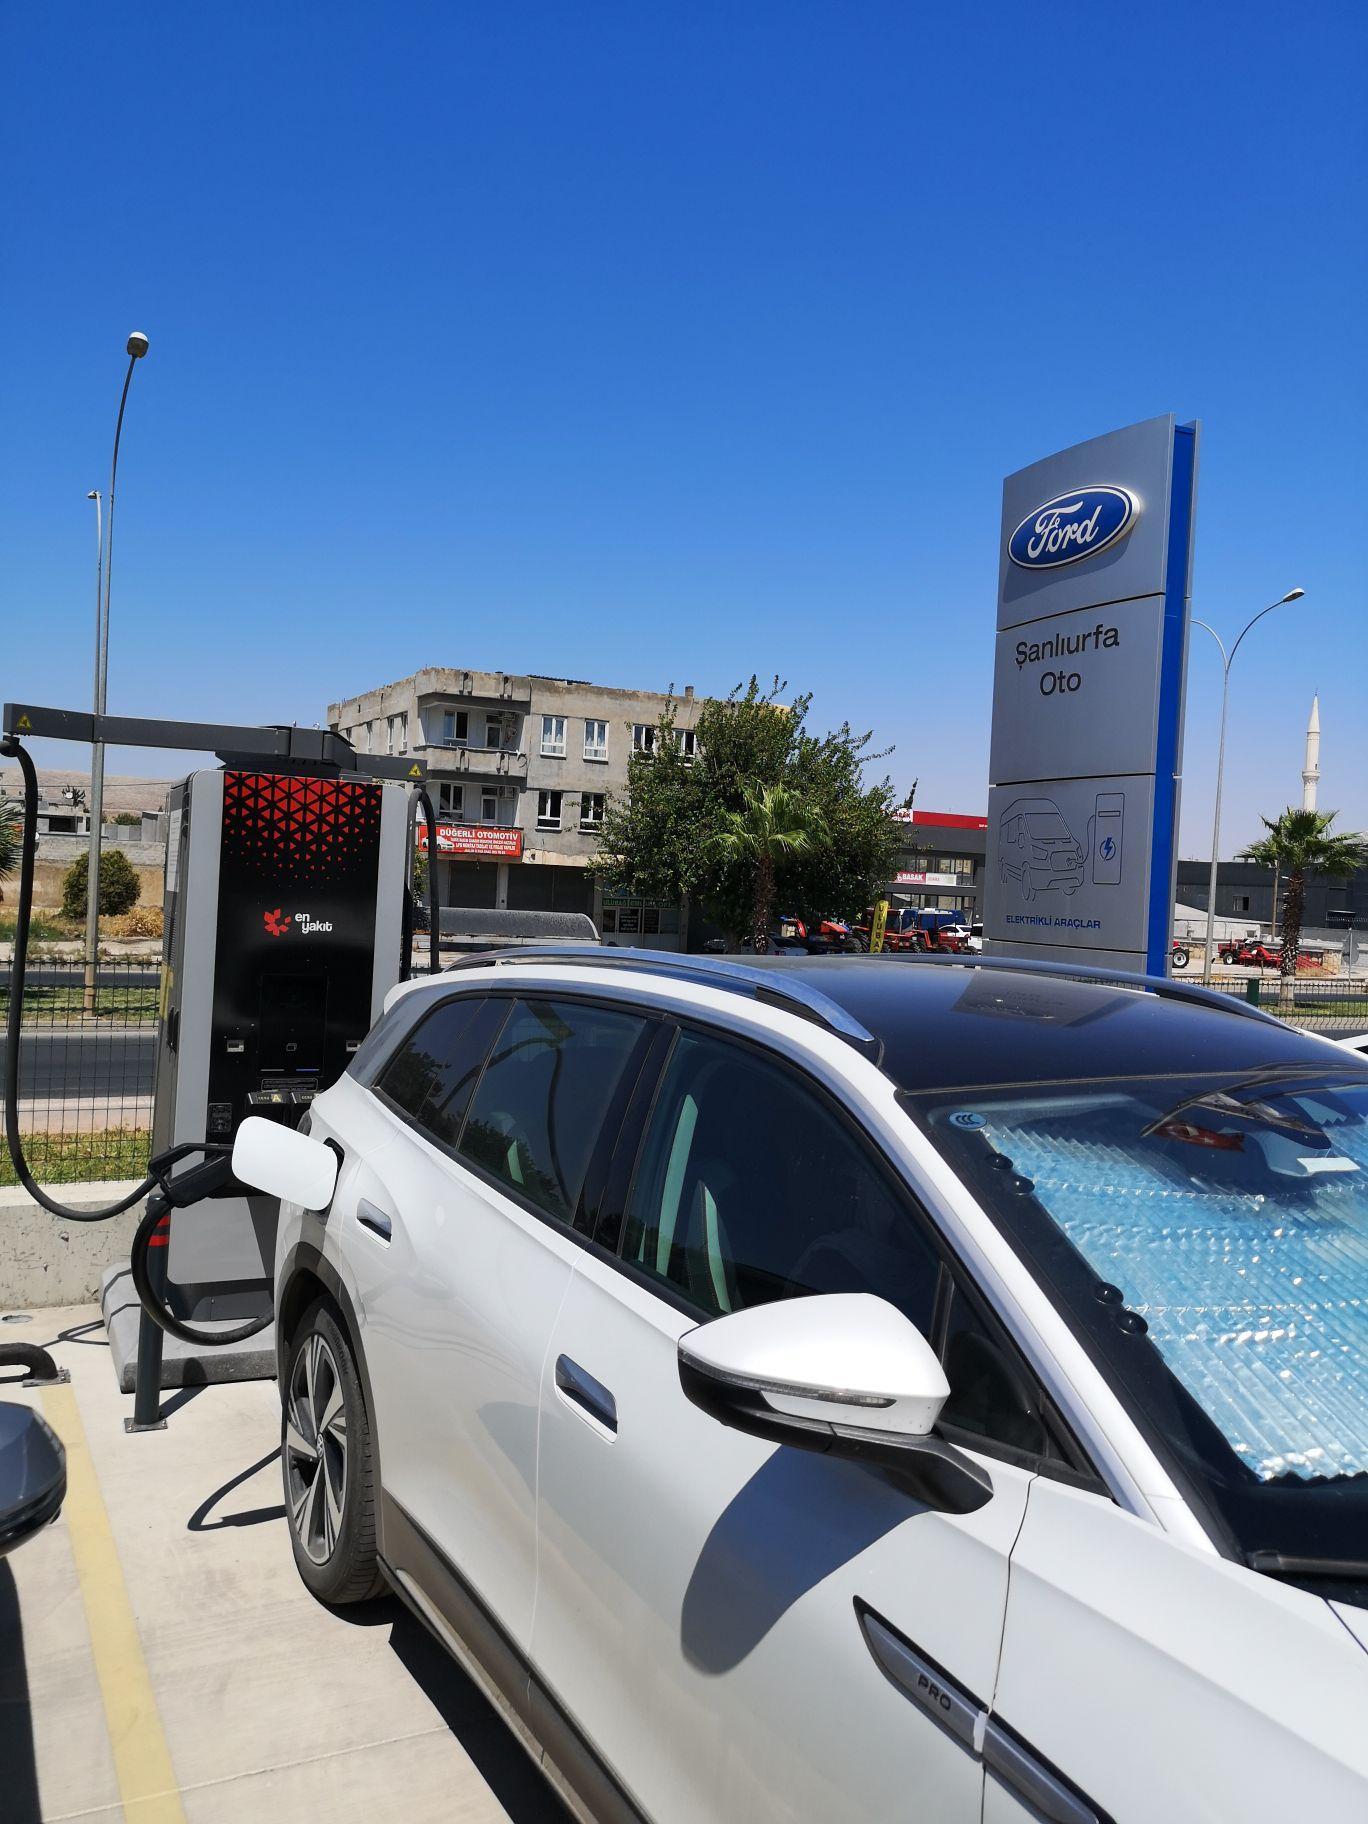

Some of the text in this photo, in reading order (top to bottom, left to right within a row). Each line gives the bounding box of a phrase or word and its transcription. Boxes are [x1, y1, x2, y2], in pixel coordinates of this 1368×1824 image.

[1028, 501, 1102, 559] Ford
[1016, 624, 1119, 671] Şanlıurfa
[1040, 671, 1081, 696] Oto
[440, 828, 518, 841] DÜĞERLİ OTOMOTİV
[295, 913, 310, 922] en
[302, 921, 333, 934] yakıt
[1006, 915, 1101, 930] ELEKTRİKLİ ARAÇLAR
[918, 1674, 952, 1711] PRO
